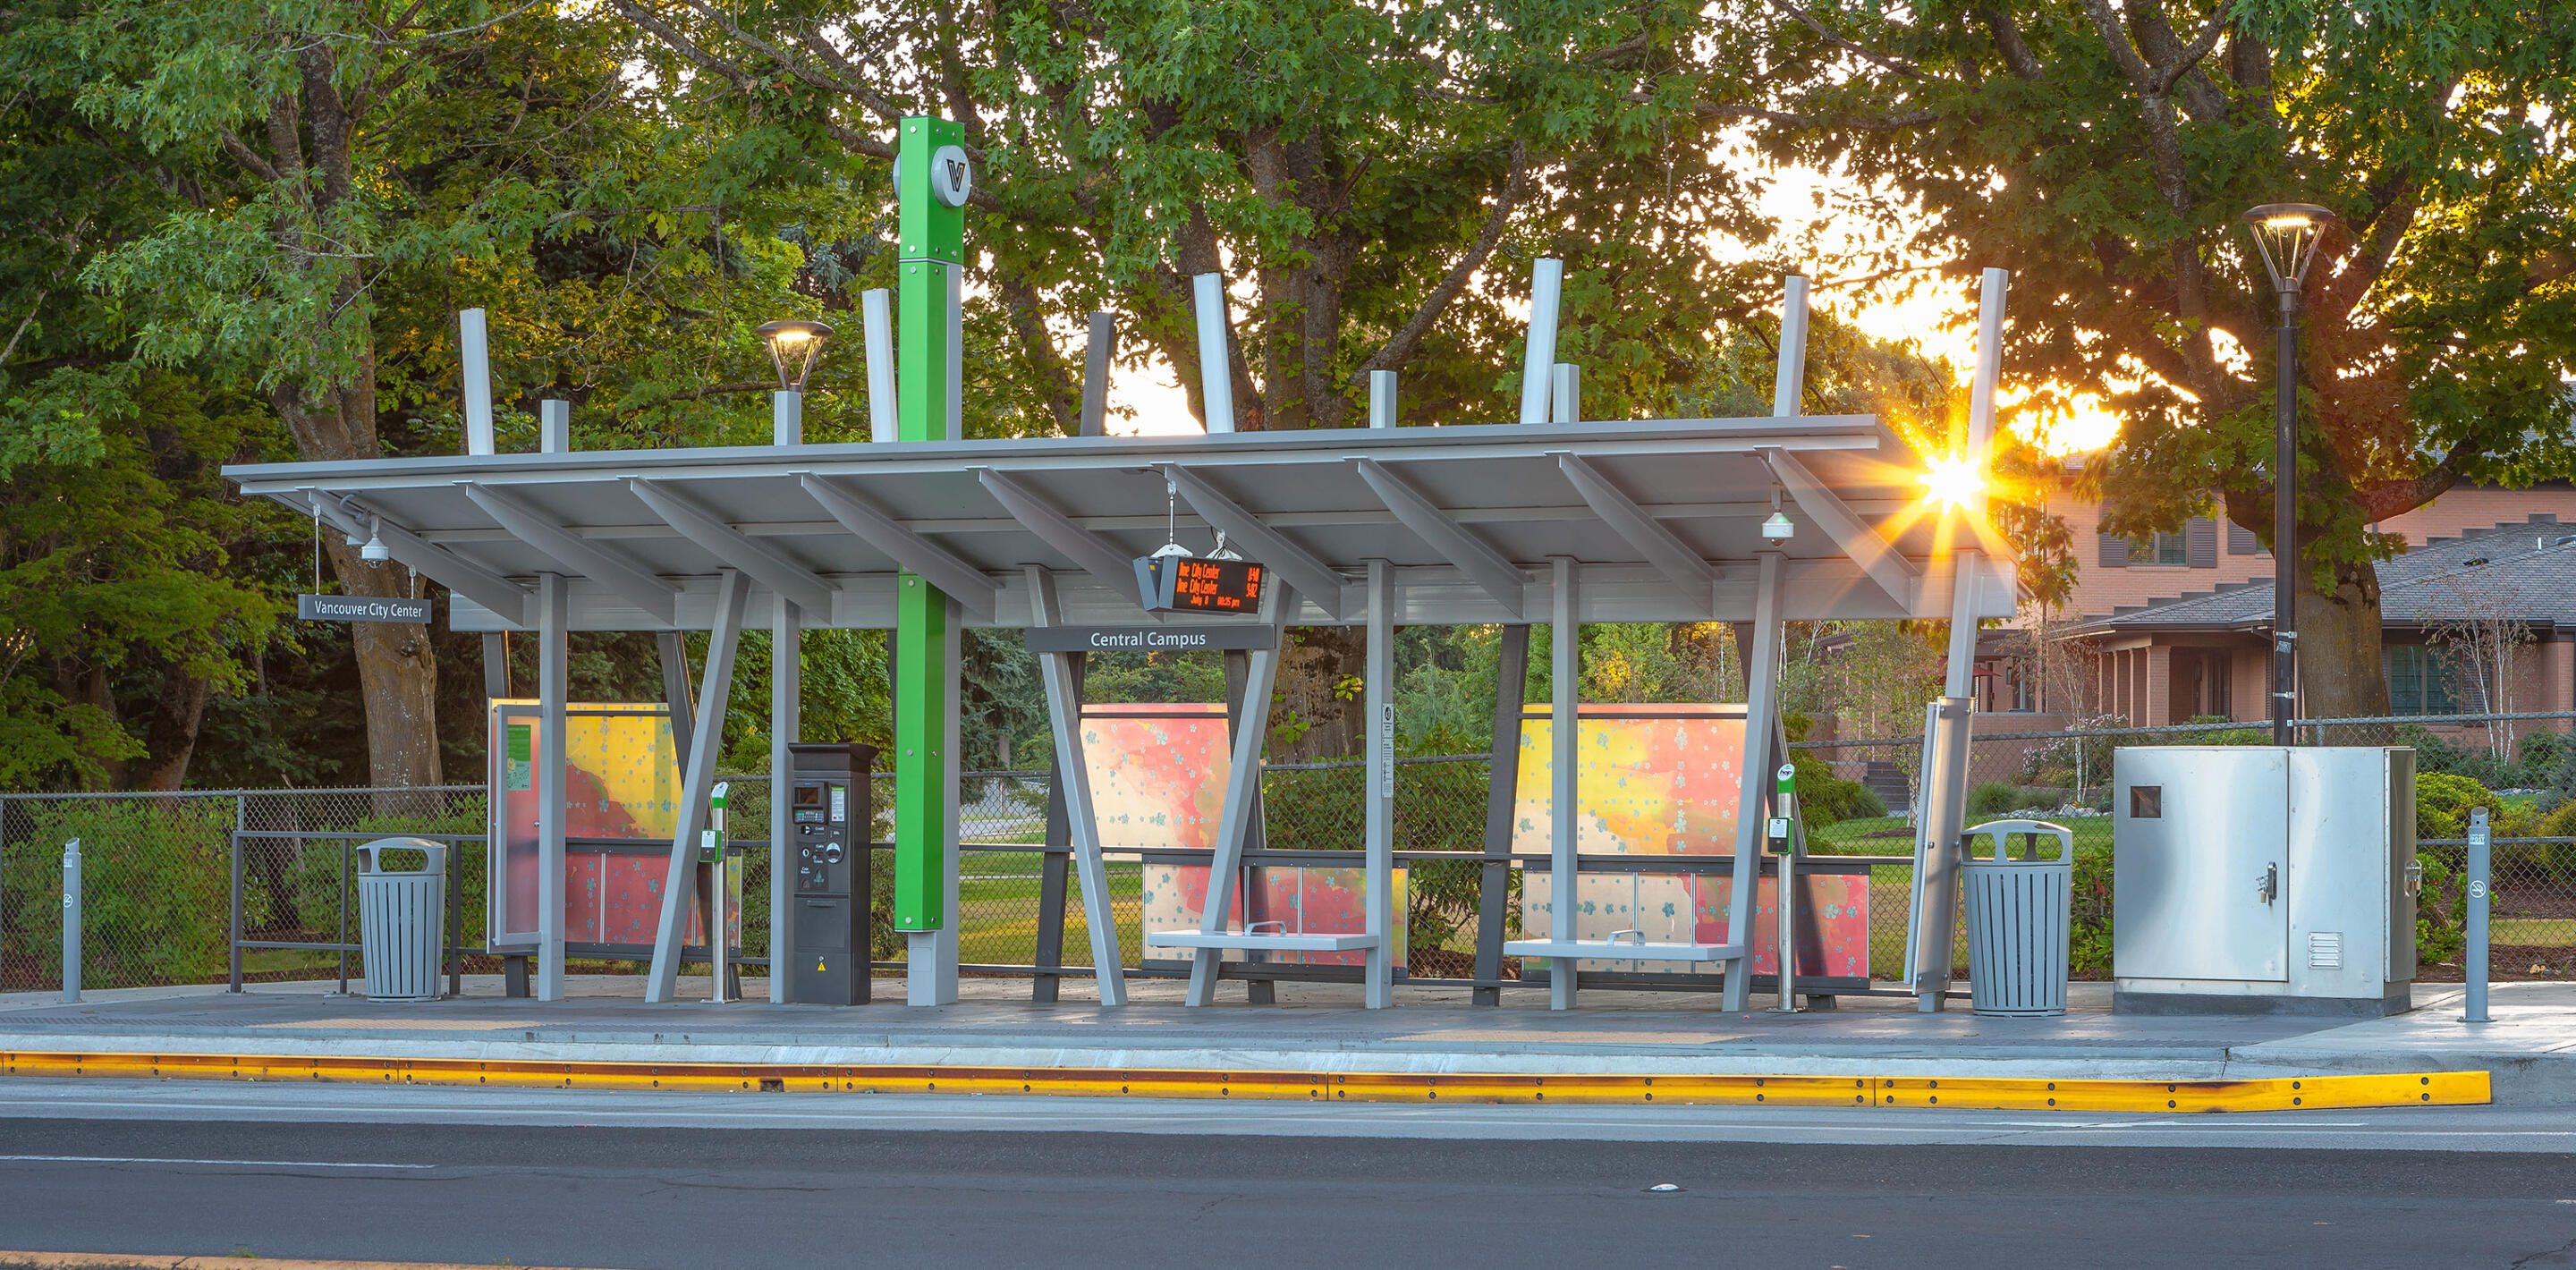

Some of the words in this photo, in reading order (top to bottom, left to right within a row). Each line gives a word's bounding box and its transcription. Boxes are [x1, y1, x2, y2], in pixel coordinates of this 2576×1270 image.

[1191, 563, 1203, 580] City
[1203, 563, 1221, 580] Center
[1190, 579, 1200, 596] City
[1200, 580, 1218, 596] Center
[314, 600, 367, 616] Vancouver
[369, 603, 389, 620] City
[391, 604, 423, 618] Center
[1090, 631, 1143, 647] Central
[1147, 632, 1207, 649] Campus
